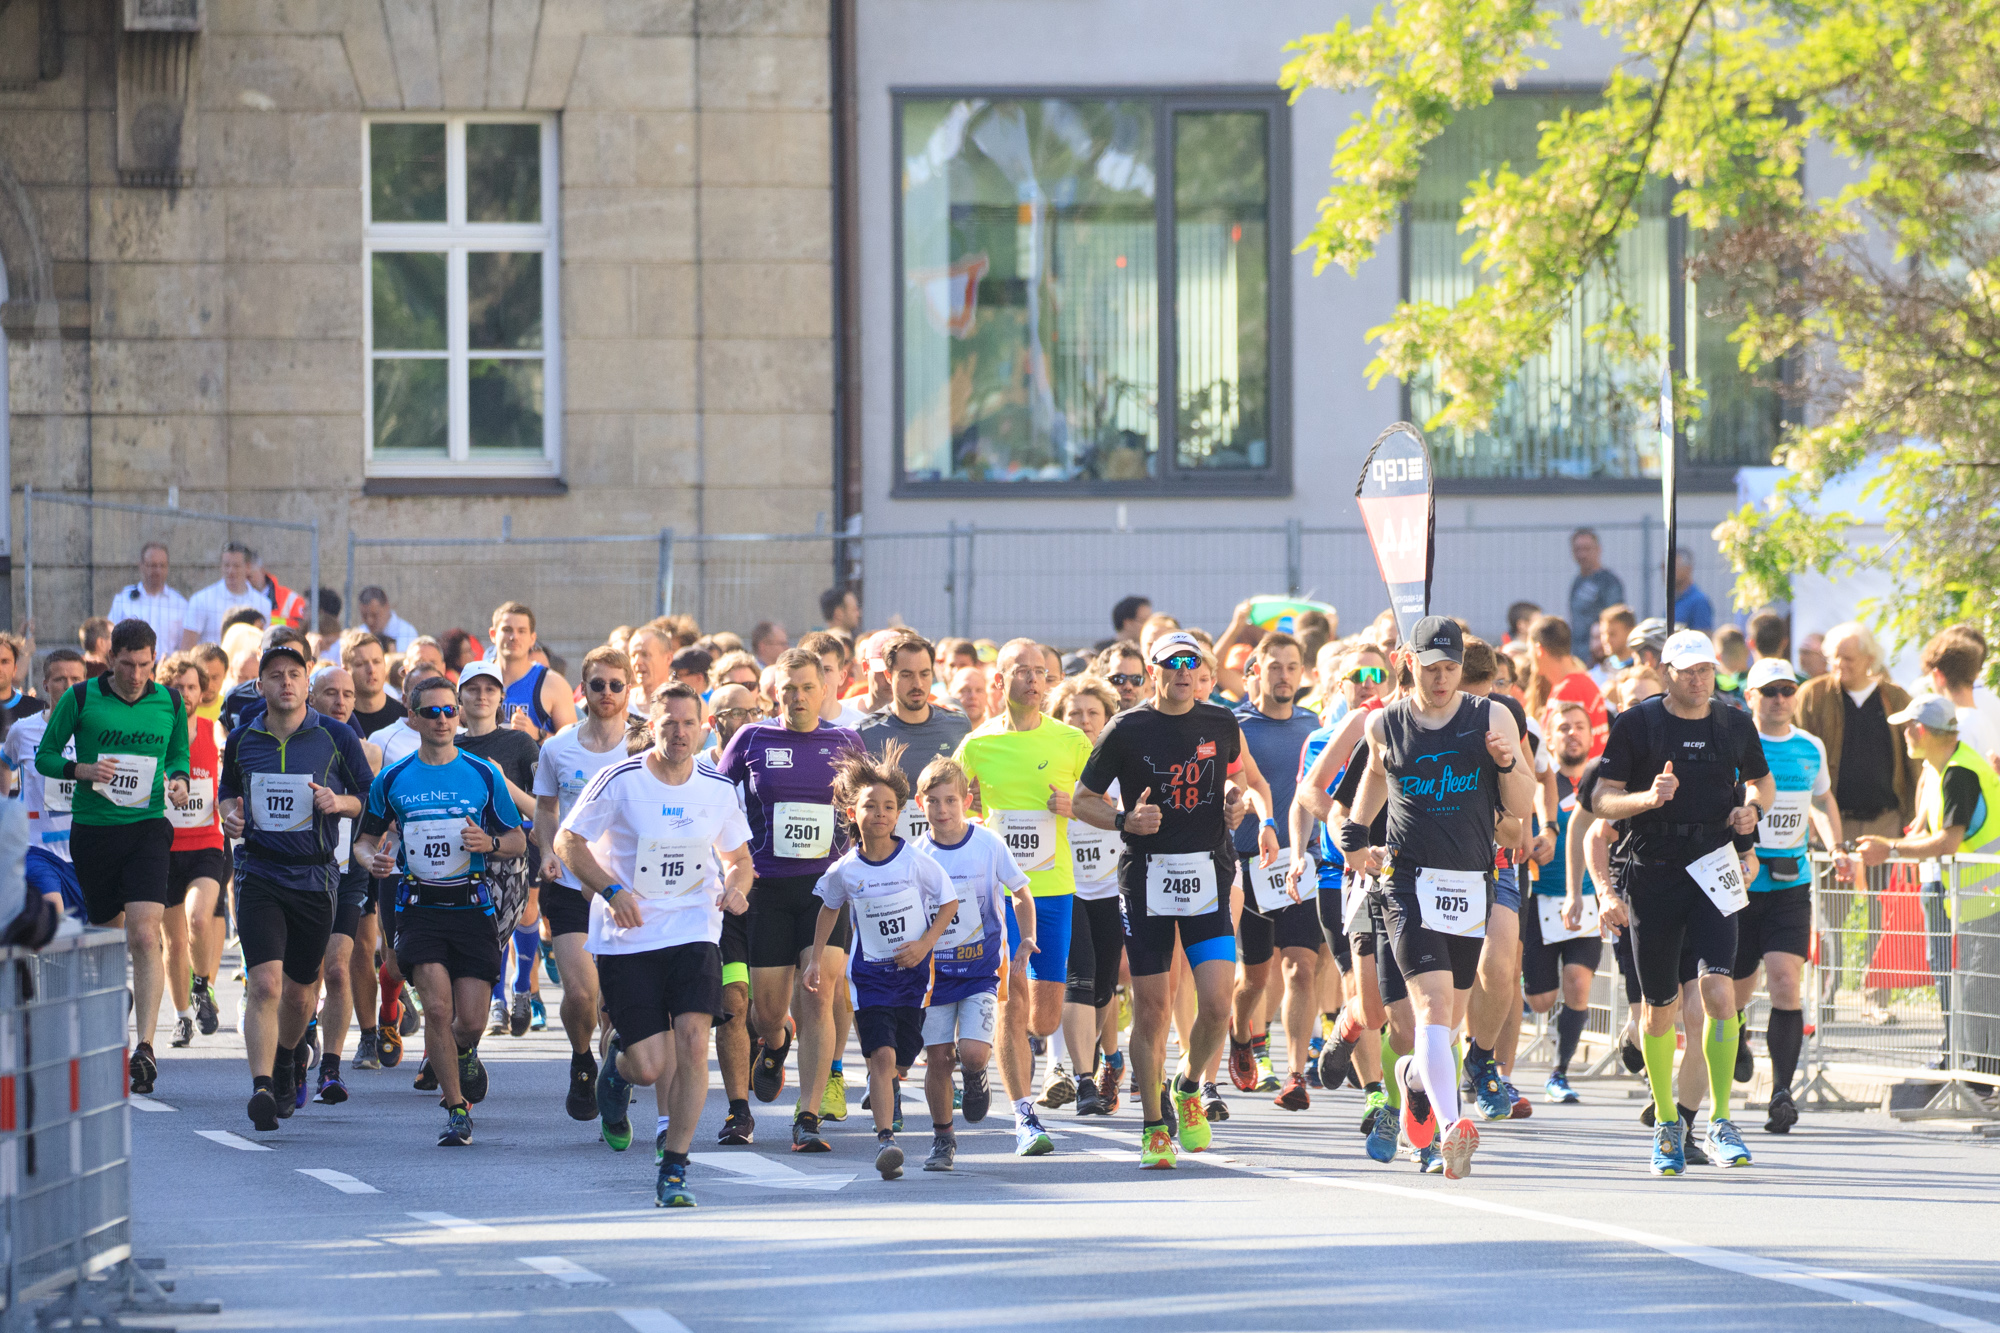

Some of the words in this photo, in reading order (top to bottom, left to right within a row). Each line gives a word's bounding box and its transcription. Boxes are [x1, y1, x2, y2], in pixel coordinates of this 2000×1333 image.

[97, 729, 165, 747] Metten
[109, 773, 139, 790] 2116
[1169, 764, 1200, 786] 20
[1398, 776, 1435, 798] Run
[1435, 764, 1481, 802] fleet!
[111, 788, 133, 796] Matthias
[1172, 787, 1199, 810] 18
[266, 796, 294, 812] 1712
[1426, 805, 1461, 813] HAMBURG
[1766, 813, 1802, 829] 10267
[784, 823, 821, 841] 2501
[791, 841, 812, 849] Jochen
[1003, 833, 1040, 849] 1499
[423, 841, 451, 859] 429
[1011, 851, 1035, 859] ernhard
[1075, 846, 1101, 863] 814
[431, 859, 446, 867] Rene
[659, 861, 685, 878] 115
[1162, 876, 1201, 895] 2489
[1718, 869, 1740, 890] 380
[1443, 913, 1459, 921] Peter
[878, 916, 907, 937] 837
[887, 935, 904, 944] Jonas
[956, 943, 984, 960] 2018
